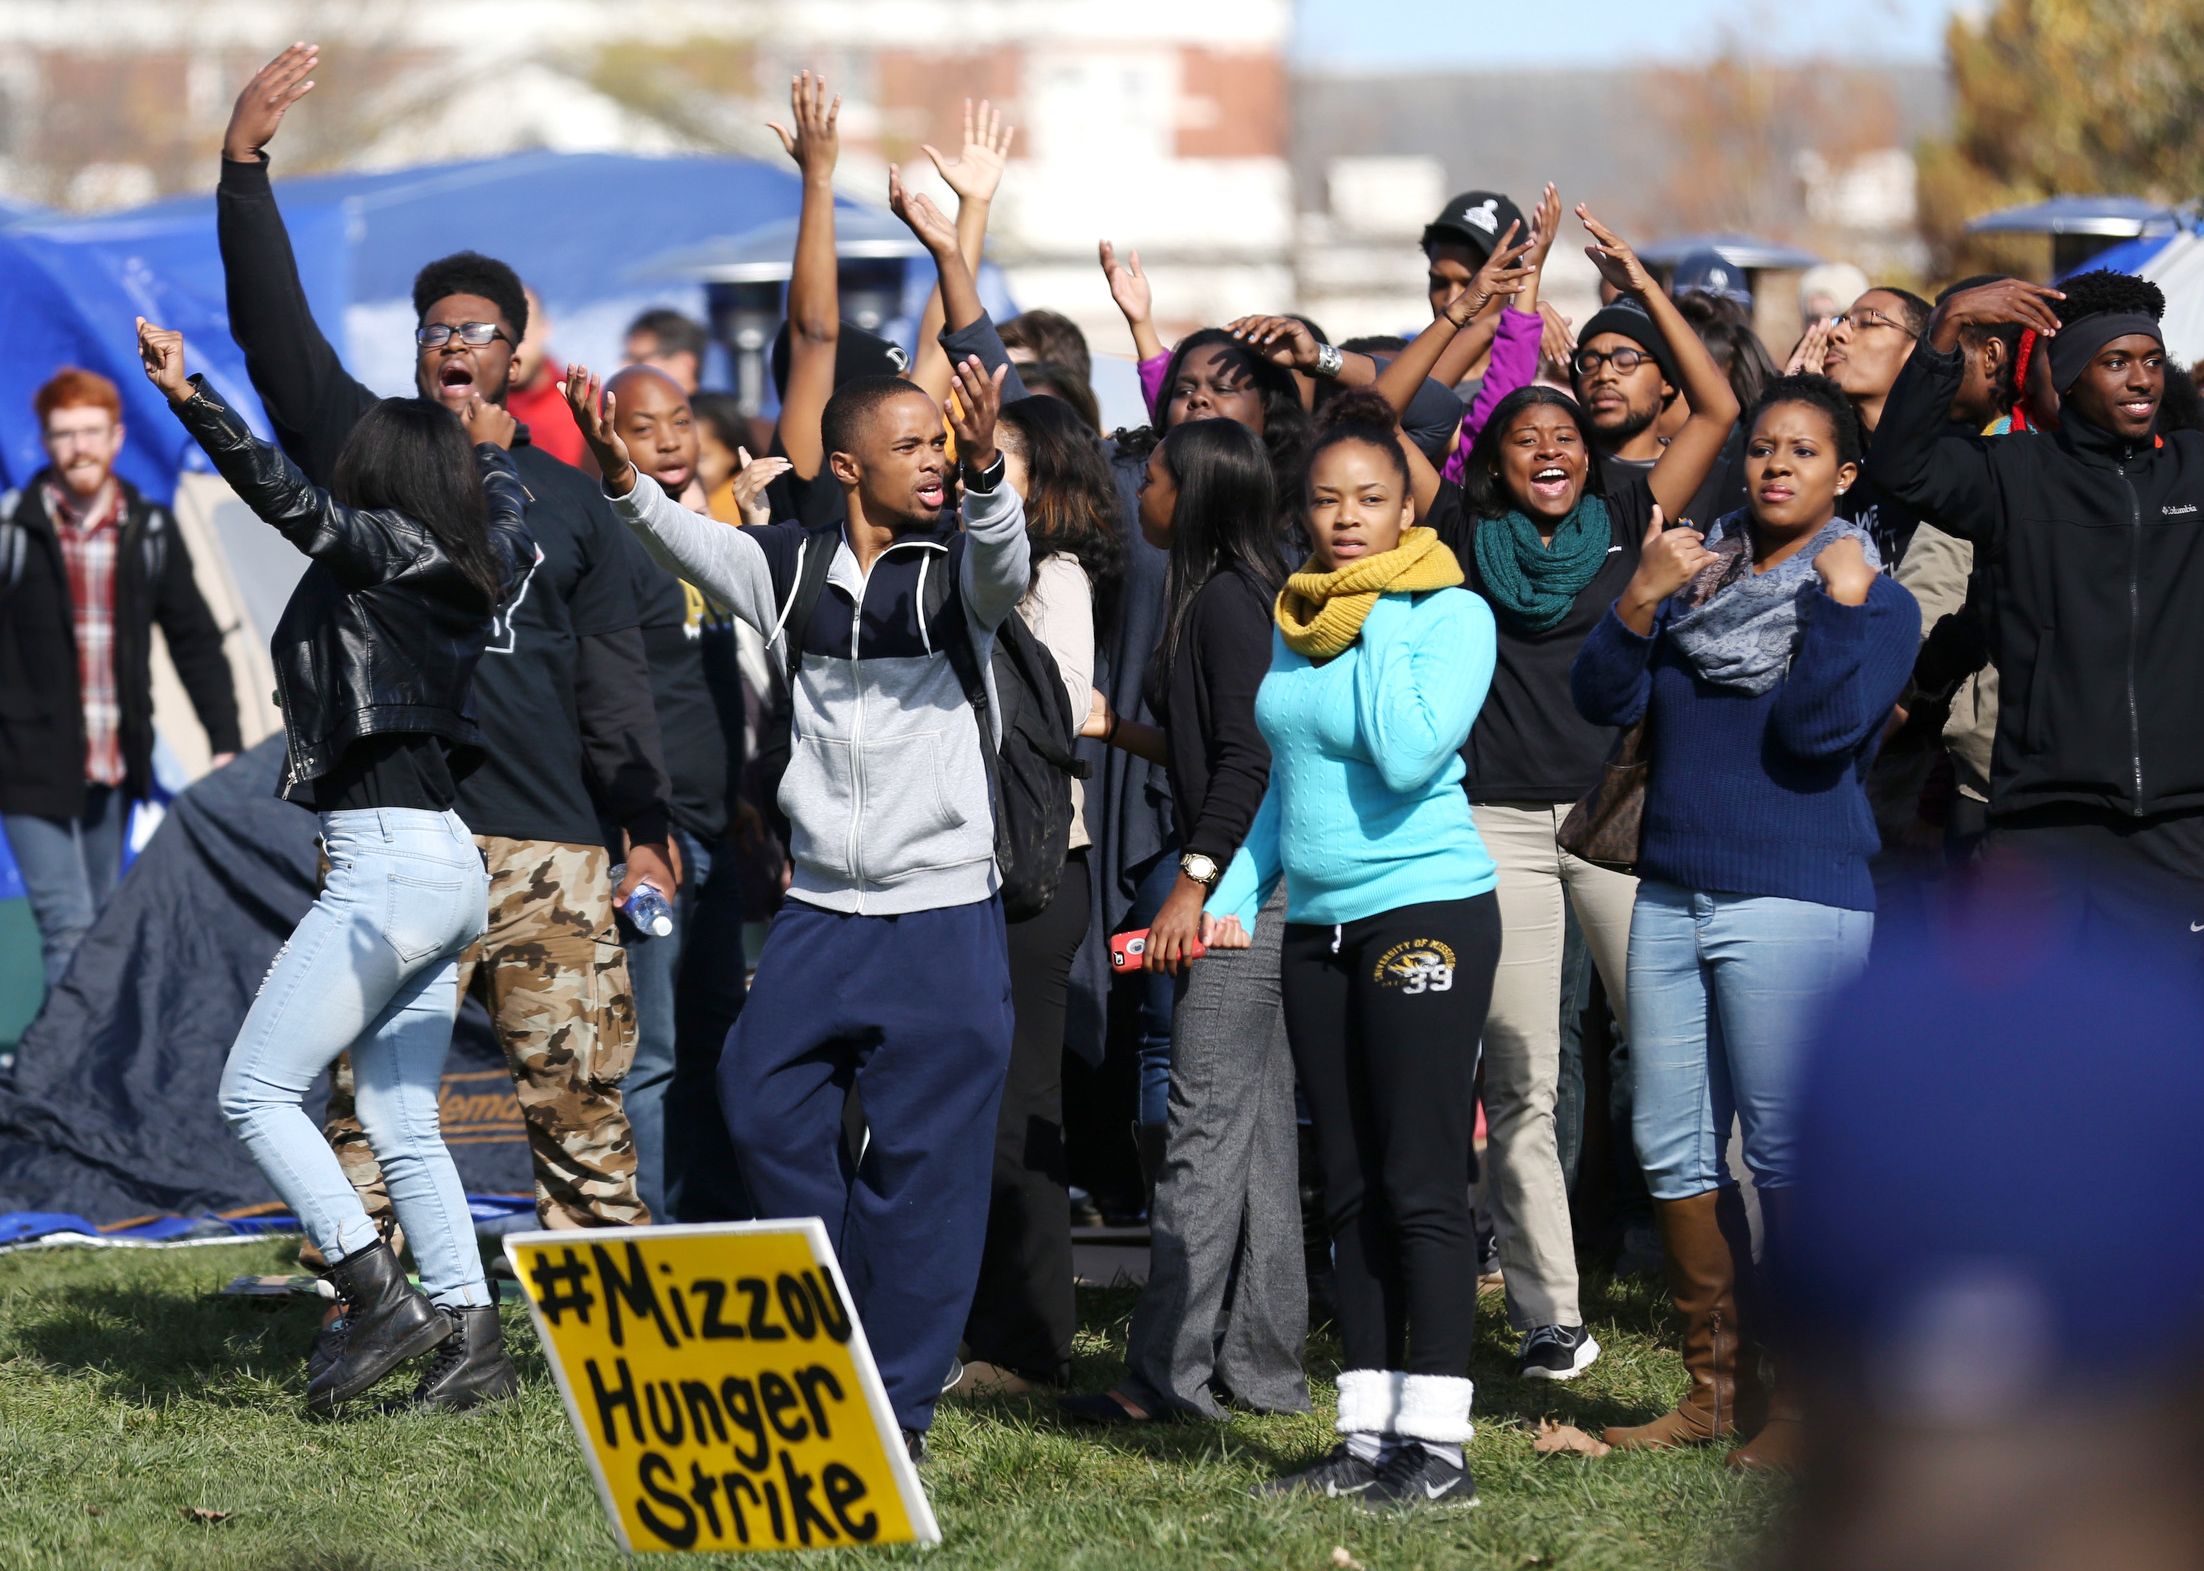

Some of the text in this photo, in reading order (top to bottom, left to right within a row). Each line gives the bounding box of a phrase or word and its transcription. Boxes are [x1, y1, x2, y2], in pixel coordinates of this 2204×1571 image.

[1414, 938, 1429, 948] OF
[1402, 964, 1453, 994] 39
[585, 1358, 845, 1472] Hunger
[635, 1450, 878, 1549] Strike
